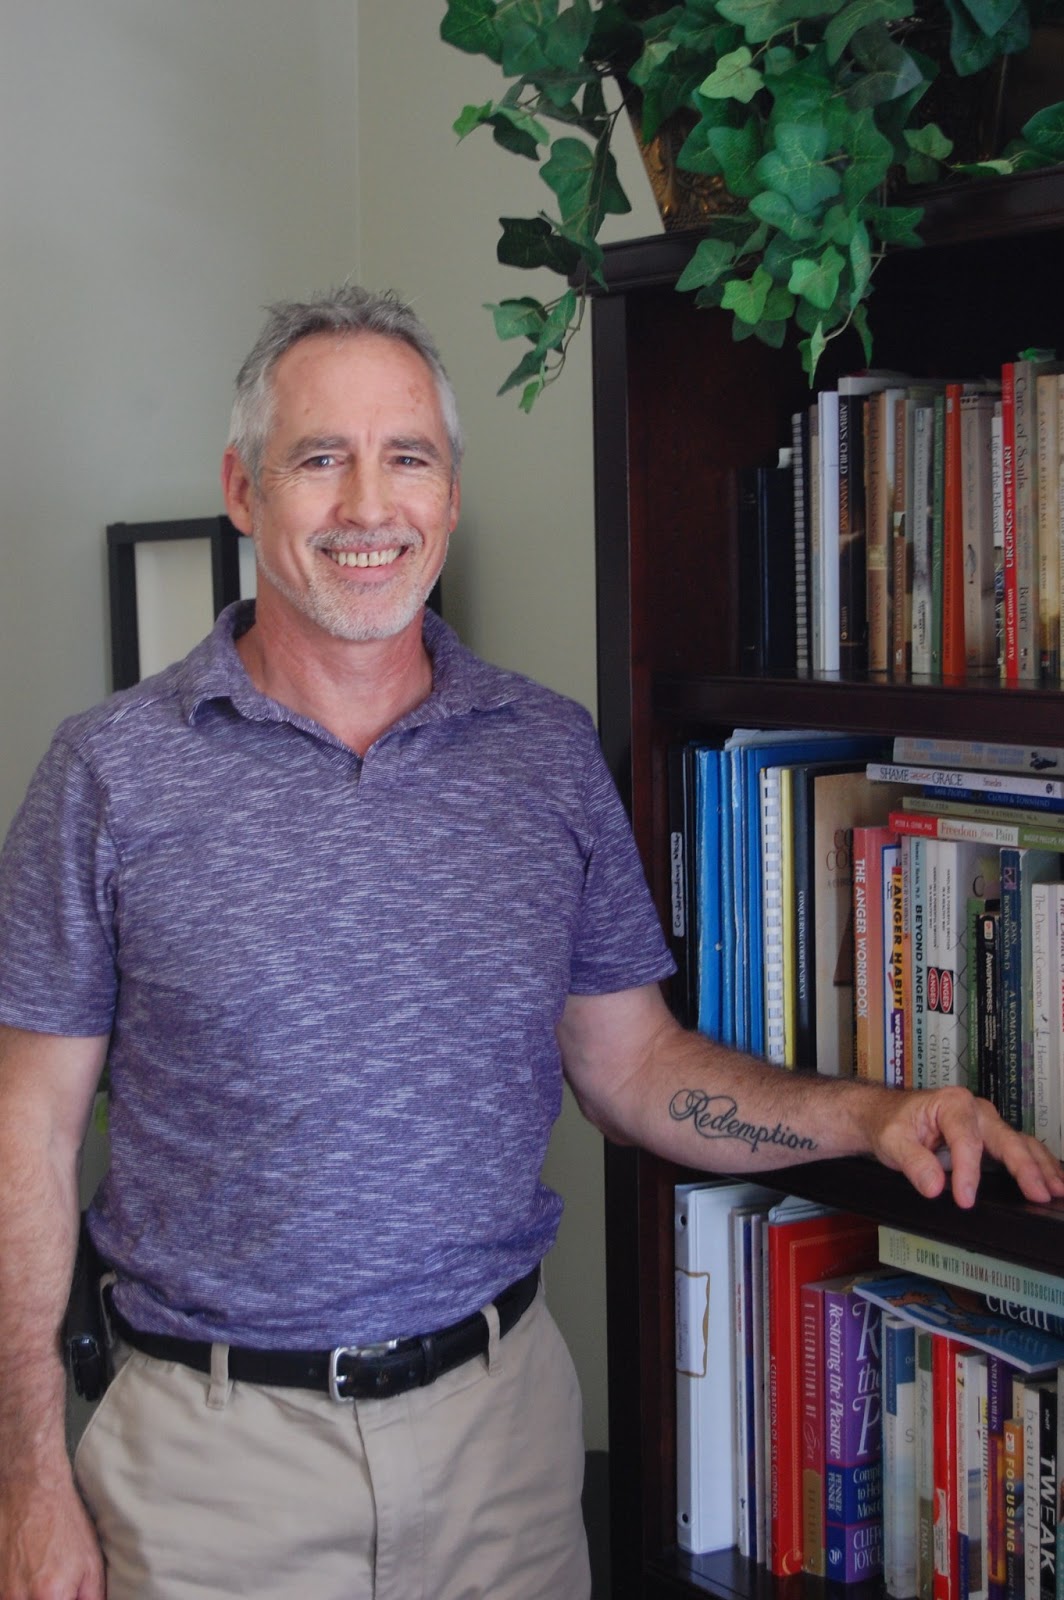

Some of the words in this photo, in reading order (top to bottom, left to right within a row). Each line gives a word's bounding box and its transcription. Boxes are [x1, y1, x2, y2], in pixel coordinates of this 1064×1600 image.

[1016, 377, 1029, 416] Care
[993, 435, 1003, 454] Life
[1016, 423, 1029, 441] of
[839, 442, 849, 475] CHILD
[993, 459, 1003, 469] of
[993, 471, 1003, 486] the
[1005, 445, 1014, 485] HEART
[1016, 446, 1029, 489] Souls
[839, 478, 849, 531] MANNING
[993, 491, 1003, 532] Beloved
[1005, 508, 1014, 568] URGINGS
[995, 564, 1004, 638] NOUWEN
[1006, 588, 1015, 623] Cannon
[1019, 586, 1030, 632] Benner
[1006, 628, 1015, 646] and
[1006, 650, 1015, 660] Au
[880, 767, 910, 782] SHAME
[932, 771, 963, 787] GRACE
[942, 820, 978, 839] Freedom
[996, 827, 1014, 842] Pain
[855, 859, 867, 882] THE
[798, 890, 806, 940] CONQUERING
[855, 888, 867, 933] ANGER
[893, 885, 904, 946] ANGER
[1034, 894, 1047, 911] The
[915, 905, 923, 962] BEYOND
[1010, 921, 1018, 945] JOAN
[1034, 913, 1047, 940] Dance
[1034, 944, 1047, 956] of
[798, 941, 806, 1001] CODEPENDENCY
[855, 938, 867, 1018] WORKBOOK
[893, 952, 904, 1007] HABIT
[915, 965, 923, 1014] ANGER
[985, 952, 995, 1014] Awareness:
[1034, 956, 1047, 1008] Connection
[942, 976, 950, 1008] ANGER
[1009, 990, 1017, 998] A
[895, 1013, 904, 1085] workbook
[916, 1028, 924, 1060] guide
[929, 1033, 938, 1087] CHAPMA
[941, 1036, 950, 1082] CHAPM
[916, 1063, 924, 1079] for
[1009, 1053, 1017, 1084] BOOK
[1009, 1086, 1017, 1099] OF
[669, 1089, 818, 1153] Redemption
[916, 1247, 940, 1268] COPING
[942, 1255, 959, 1274] WITH
[961, 1260, 1021, 1294] TRAUMA-RELATED
[1023, 1279, 1064, 1307] DISSOCIATI
[827, 1302, 844, 1373] Restoring
[827, 1373, 844, 1397] the
[957, 1376, 965, 1389] 7
[990, 1354, 998, 1387] ENDED
[770, 1363, 778, 1425] CELEBRATION
[990, 1388, 998, 1431] FAMILIES
[770, 1428, 778, 1441] OF
[827, 1399, 844, 1460] Pleasure
[770, 1443, 778, 1460] SEX
[1026, 1408, 1039, 1531] beautiful
[1006, 1457, 1015, 1553] FOCUSING
[1041, 1454, 1056, 1576] TWEAK
[853, 1526, 881, 1550] CLIFF
[1026, 1542, 1039, 1587] boy
